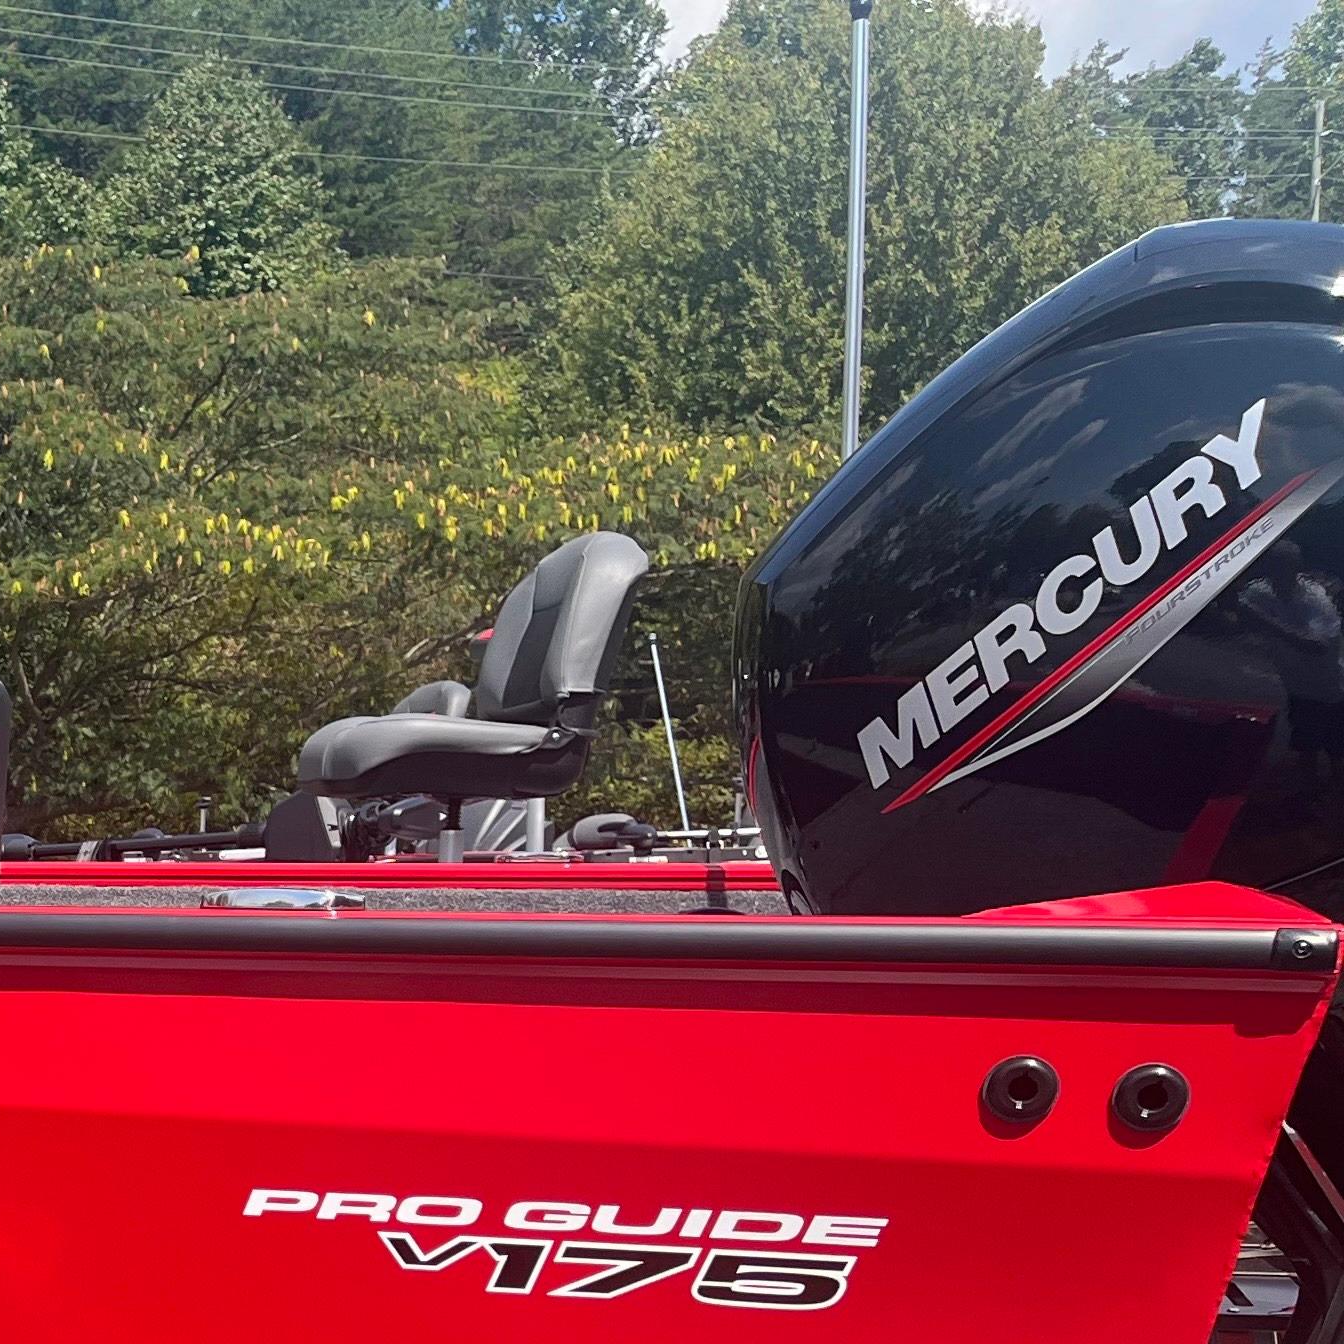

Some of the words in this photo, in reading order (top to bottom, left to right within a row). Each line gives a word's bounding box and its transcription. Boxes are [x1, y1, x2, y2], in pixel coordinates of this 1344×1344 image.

[856, 398, 1266, 789] MERCURY
[1123, 516, 1275, 646] FOURSTROKE
[243, 1188, 483, 1227] PRO
[503, 1200, 890, 1248] GUIDE
[378, 1231, 858, 1311] V175
